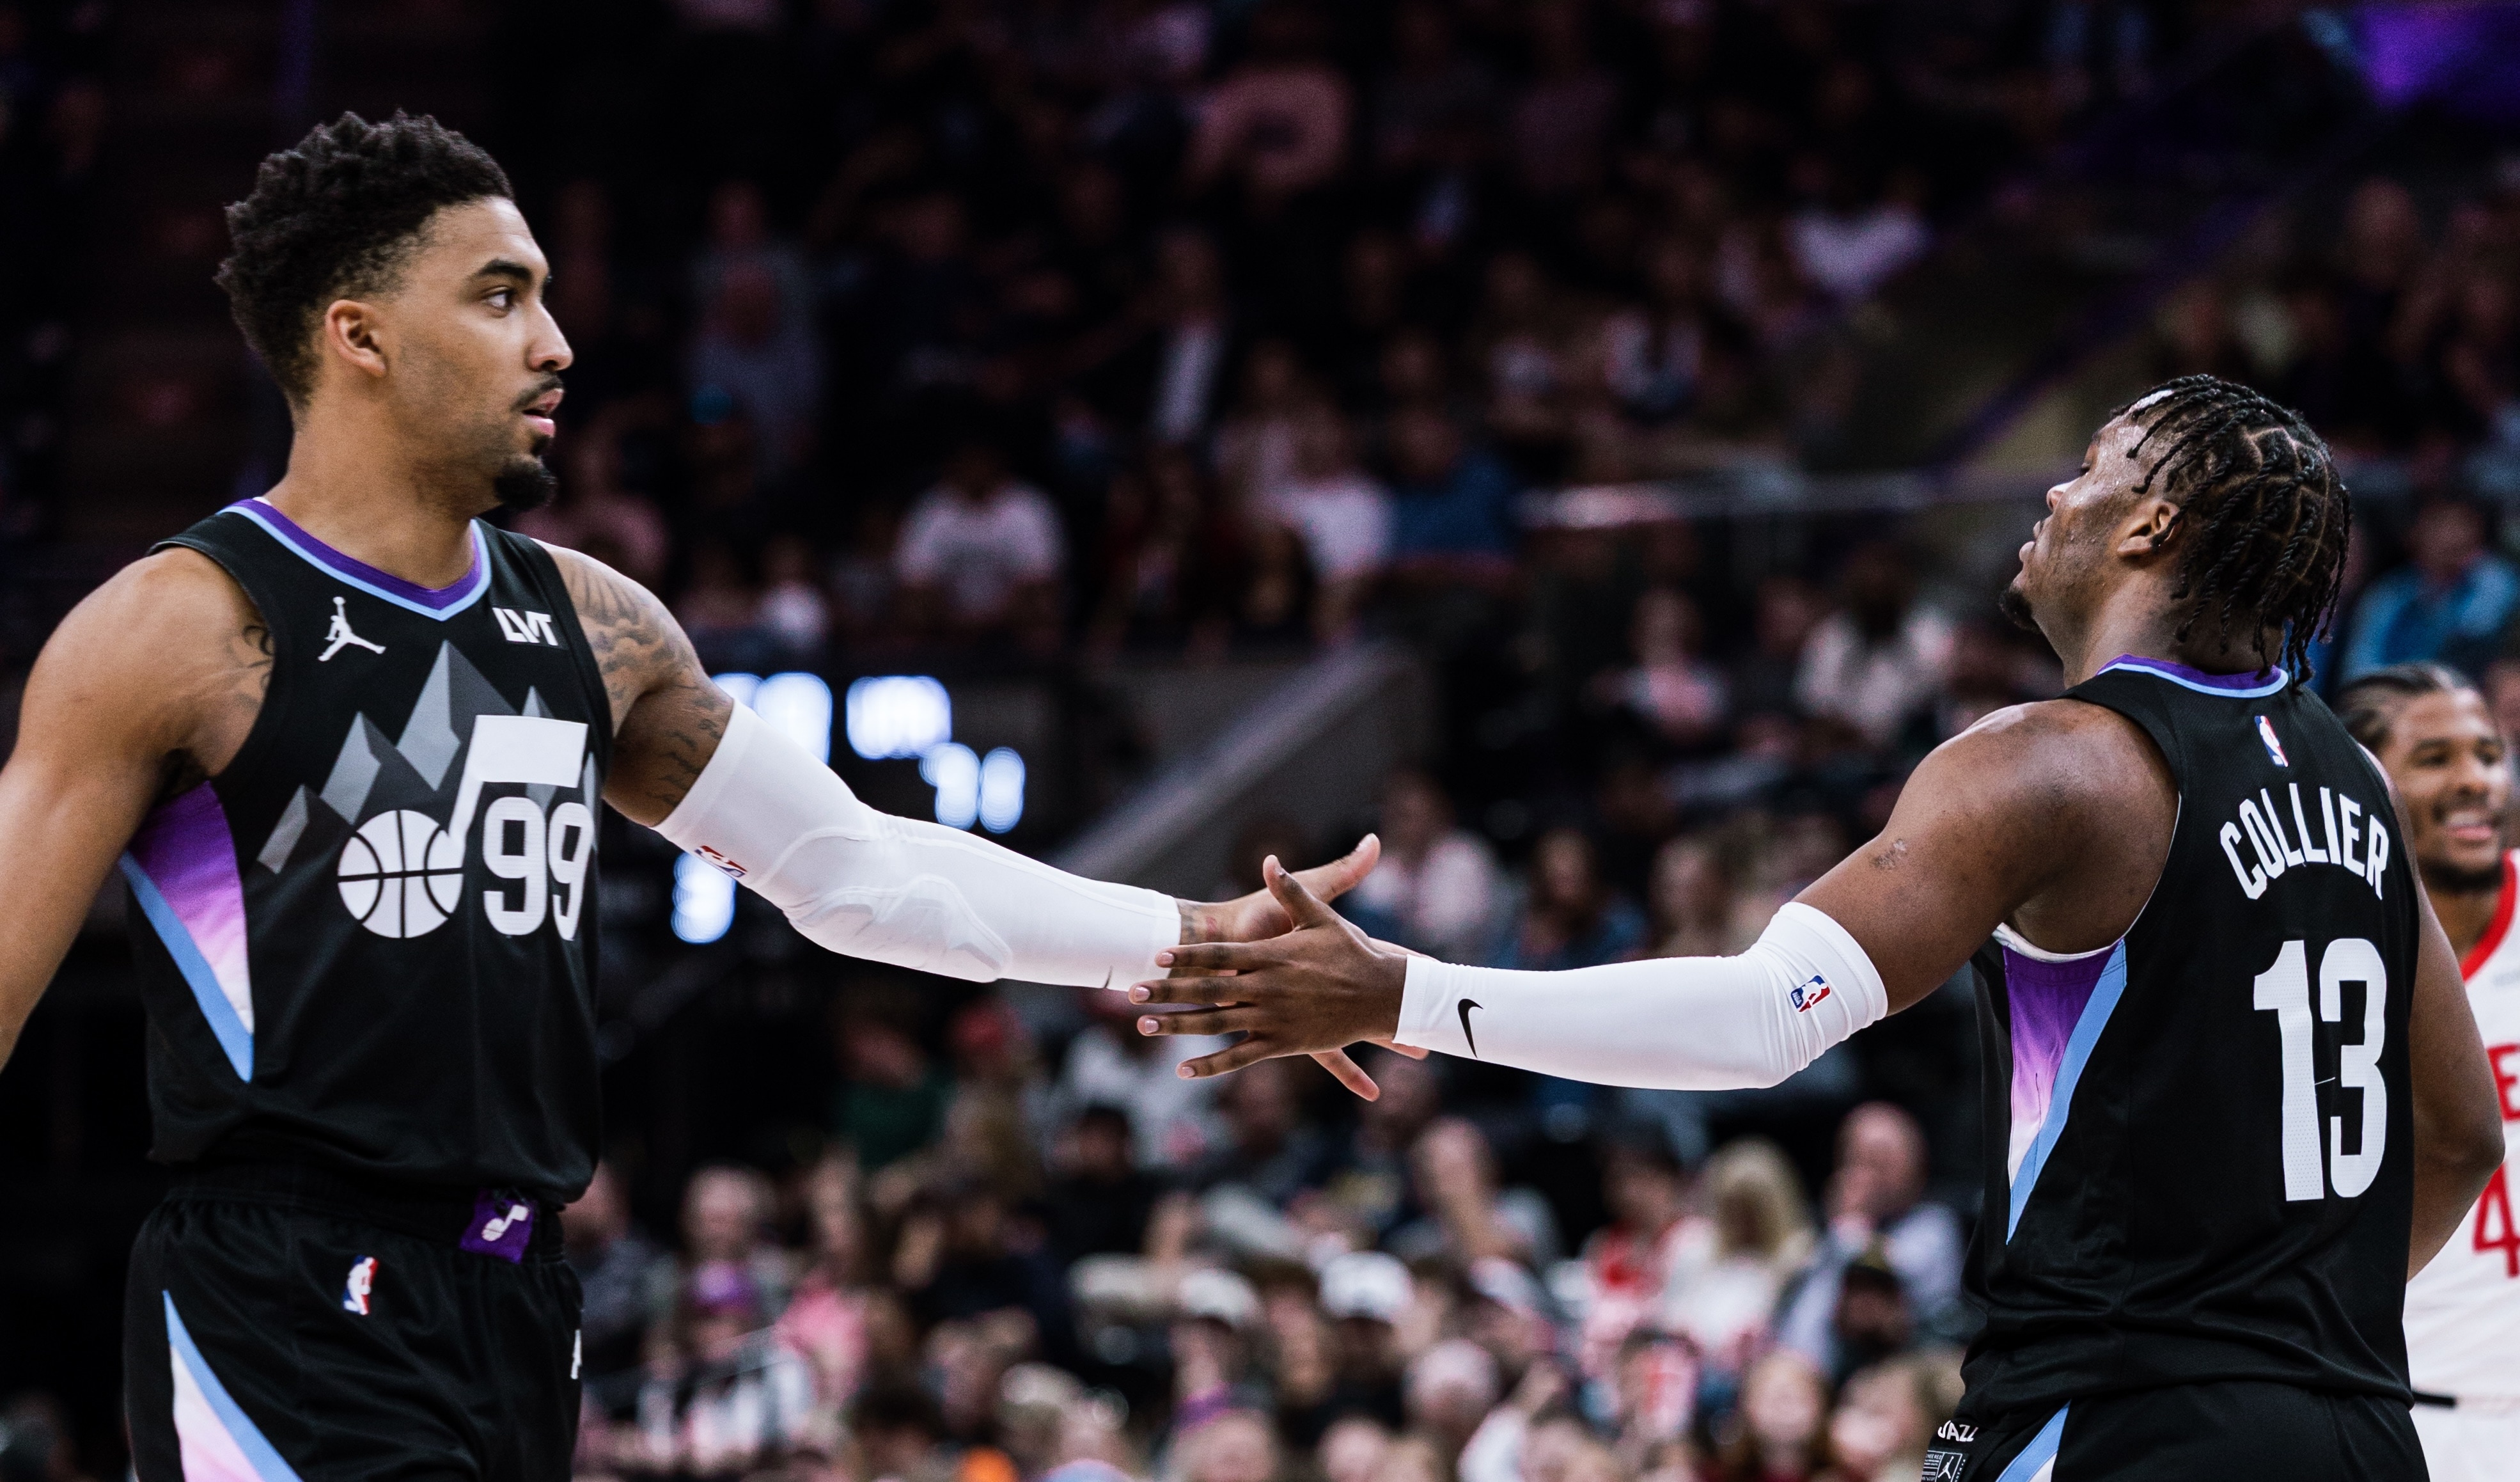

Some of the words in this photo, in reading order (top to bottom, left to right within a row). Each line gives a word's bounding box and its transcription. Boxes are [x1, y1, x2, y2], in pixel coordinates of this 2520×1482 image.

[492, 607, 558, 646] LVT
[483, 796, 595, 942] 99
[2220, 782, 2390, 901] COLLIER
[1792, 992, 1802, 1005] NBA
[2253, 938, 2387, 1202] 13
